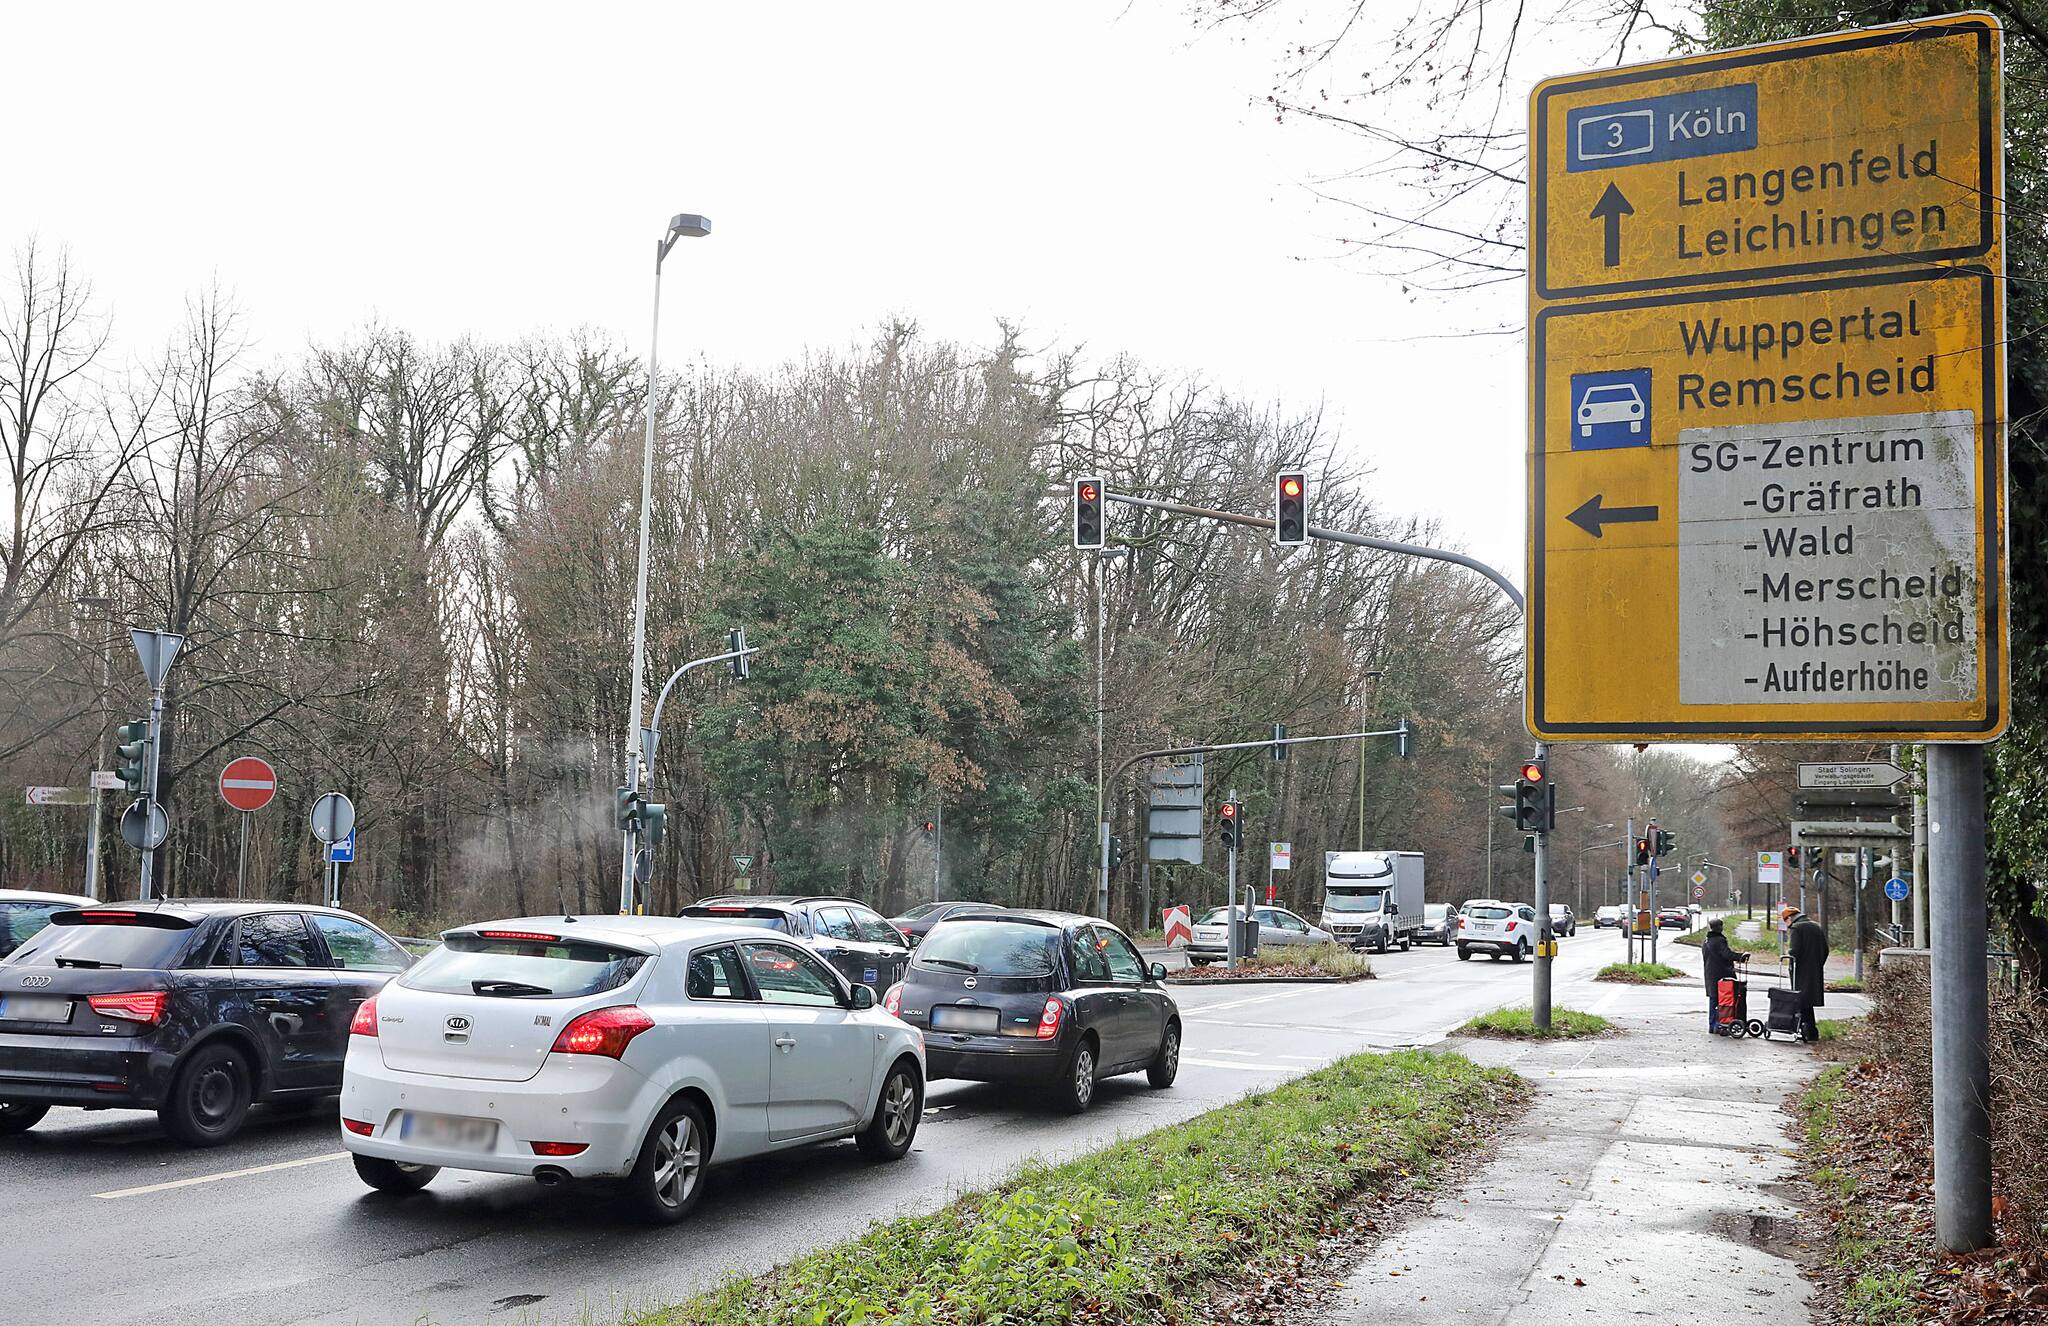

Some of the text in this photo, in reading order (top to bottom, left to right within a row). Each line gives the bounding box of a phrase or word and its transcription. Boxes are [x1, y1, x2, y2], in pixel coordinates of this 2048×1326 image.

[1607, 108, 1747, 148] 3 Köln
[1678, 140, 1938, 207] Langenfeld
[1678, 204, 1947, 260] Leichlingen
[1680, 300, 1921, 360] Wuppertal
[1678, 355, 1935, 410] Remscheid
[1691, 437, 1925, 473] SG-Zentrum
[450, 1018, 466, 1027] KIA
